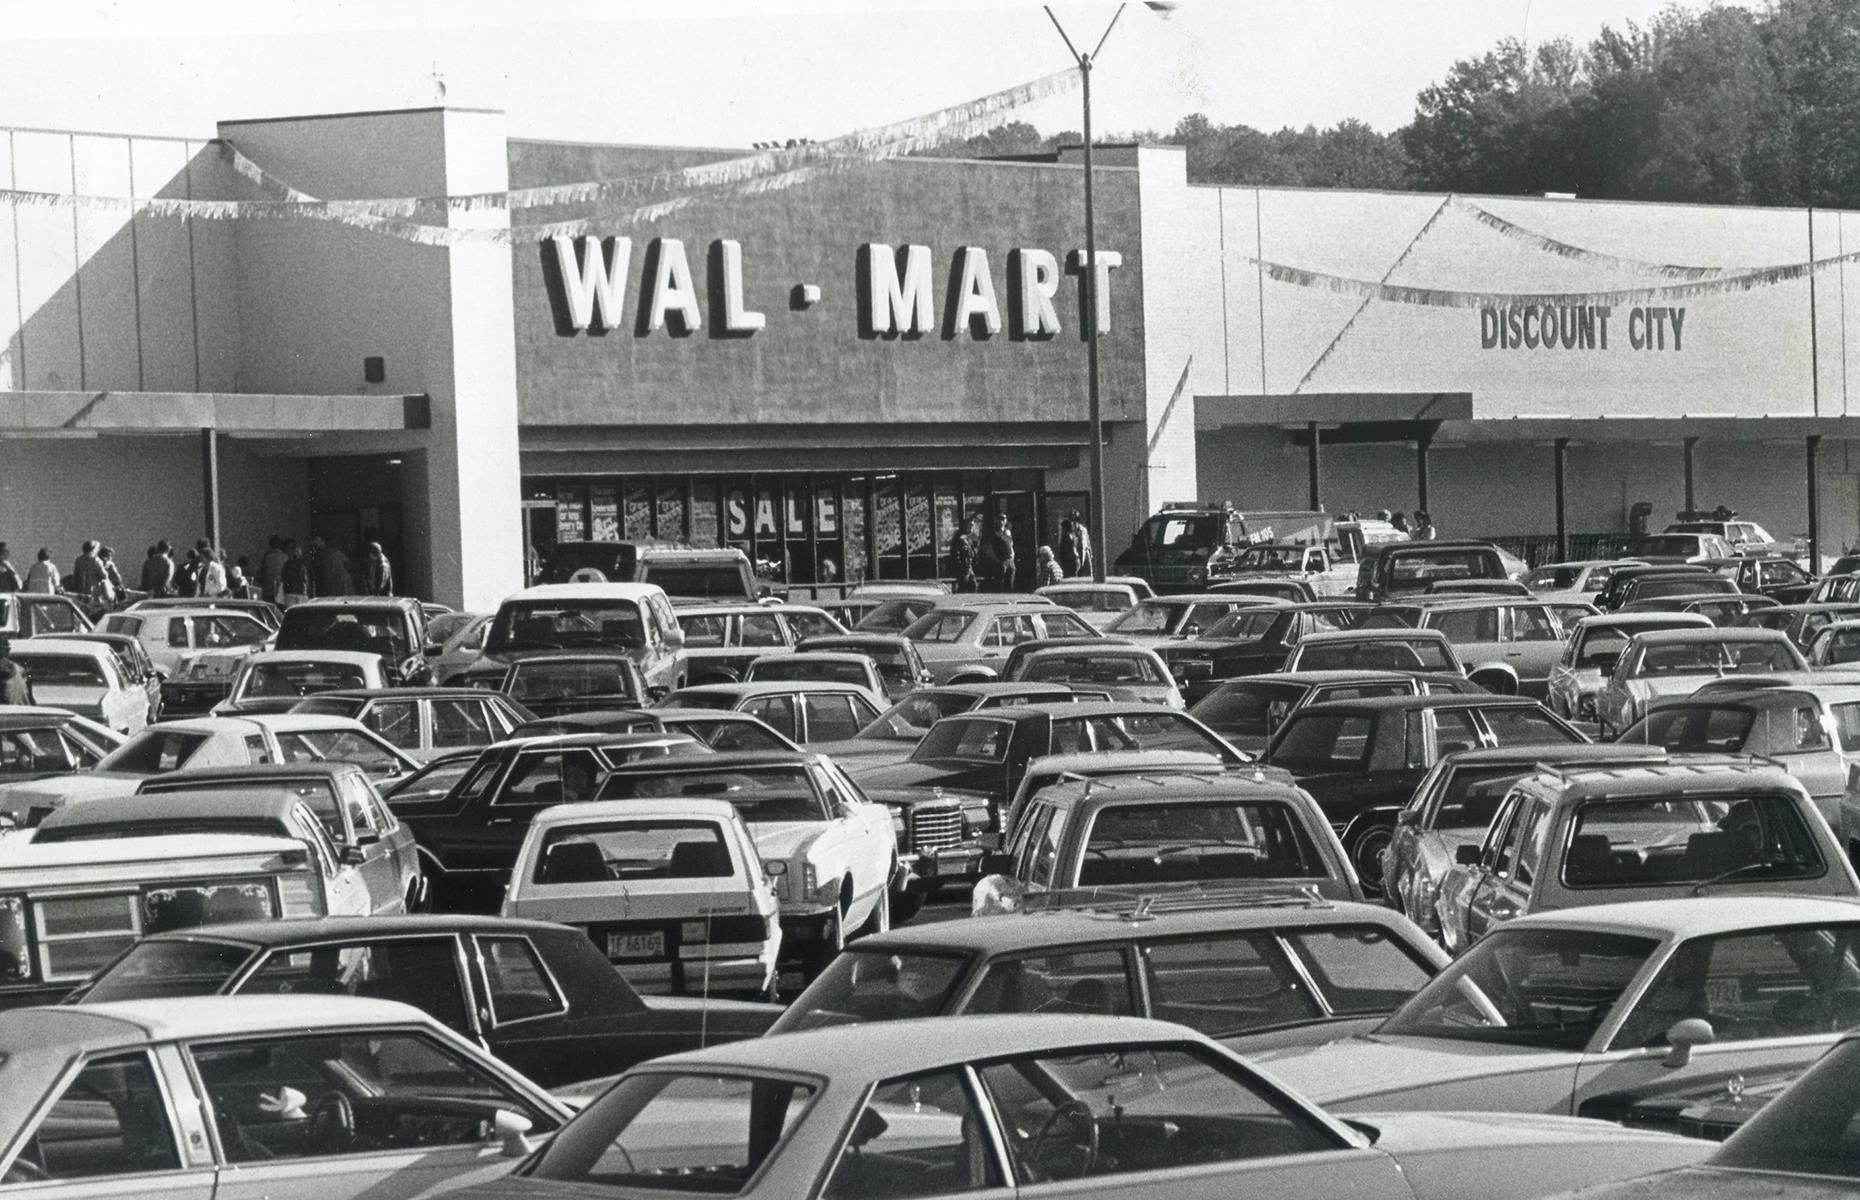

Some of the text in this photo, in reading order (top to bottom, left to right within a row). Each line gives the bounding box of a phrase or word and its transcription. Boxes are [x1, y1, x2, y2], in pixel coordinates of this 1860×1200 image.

[1481, 305, 1685, 350] DISCOUNT CITY
[729, 490, 836, 534] SALE
